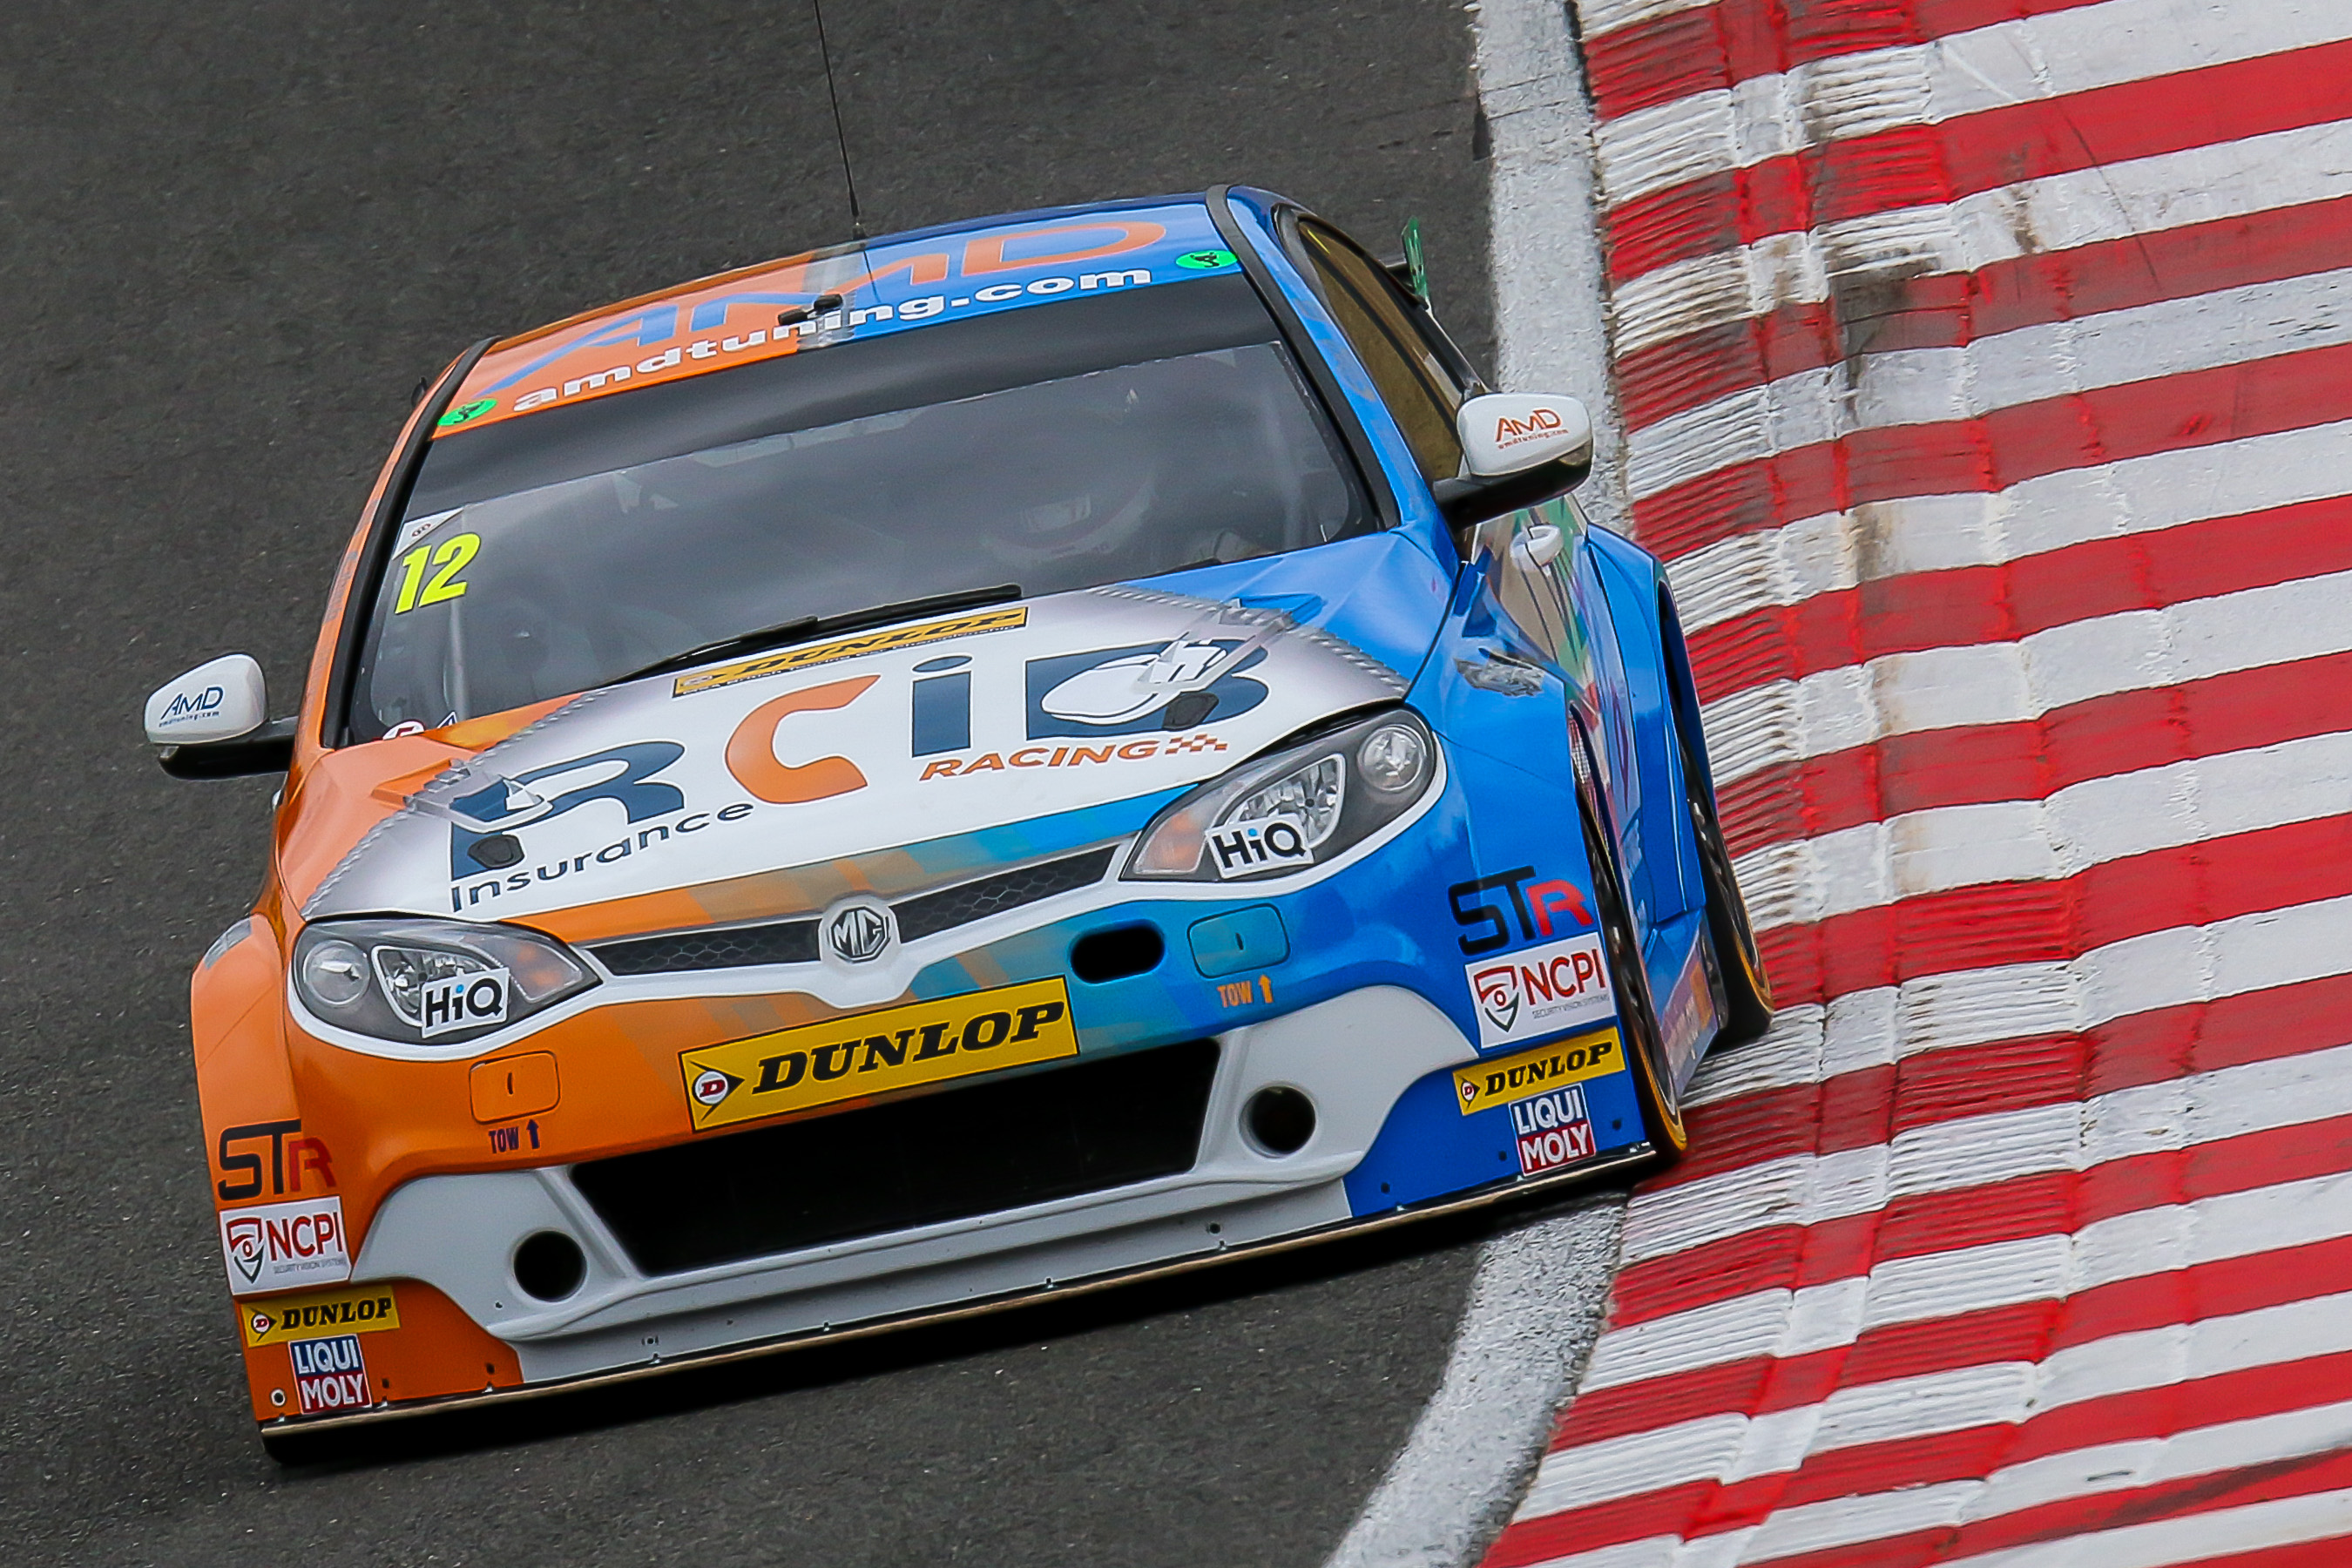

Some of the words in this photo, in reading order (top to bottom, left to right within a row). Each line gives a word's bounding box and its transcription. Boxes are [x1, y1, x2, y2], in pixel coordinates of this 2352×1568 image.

[473, 221, 1166, 400] AMD
[513, 267, 1152, 413] amdtuning.com
[1496, 409, 1561, 443] AMD
[395, 532, 481, 615] 12
[735, 612, 1023, 676] DUNLOP
[160, 686, 224, 720] AMD
[919, 740, 1160, 781] RACING
[451, 802, 754, 913] Insurance
[1212, 821, 1307, 869] HiQ
[830, 907, 887, 959] MG
[1448, 865, 1594, 956] STR
[425, 977, 504, 1028] HiQ
[1217, 980, 1254, 1008] TOW
[1520, 949, 1606, 1006] NCPI
[752, 1001, 1065, 1095] DUNLOP
[1484, 1041, 1612, 1097] DUNLOP
[1513, 1089, 1584, 1135] LIQUI
[218, 1119, 337, 1201] STR
[489, 1127, 520, 1154] TOW
[1521, 1123, 1588, 1170] MOLY
[266, 1212, 343, 1261] NCPI
[280, 1296, 392, 1331] DUNLOP
[294, 1338, 360, 1375] LIQUI
[301, 1373, 363, 1410] MOLY
